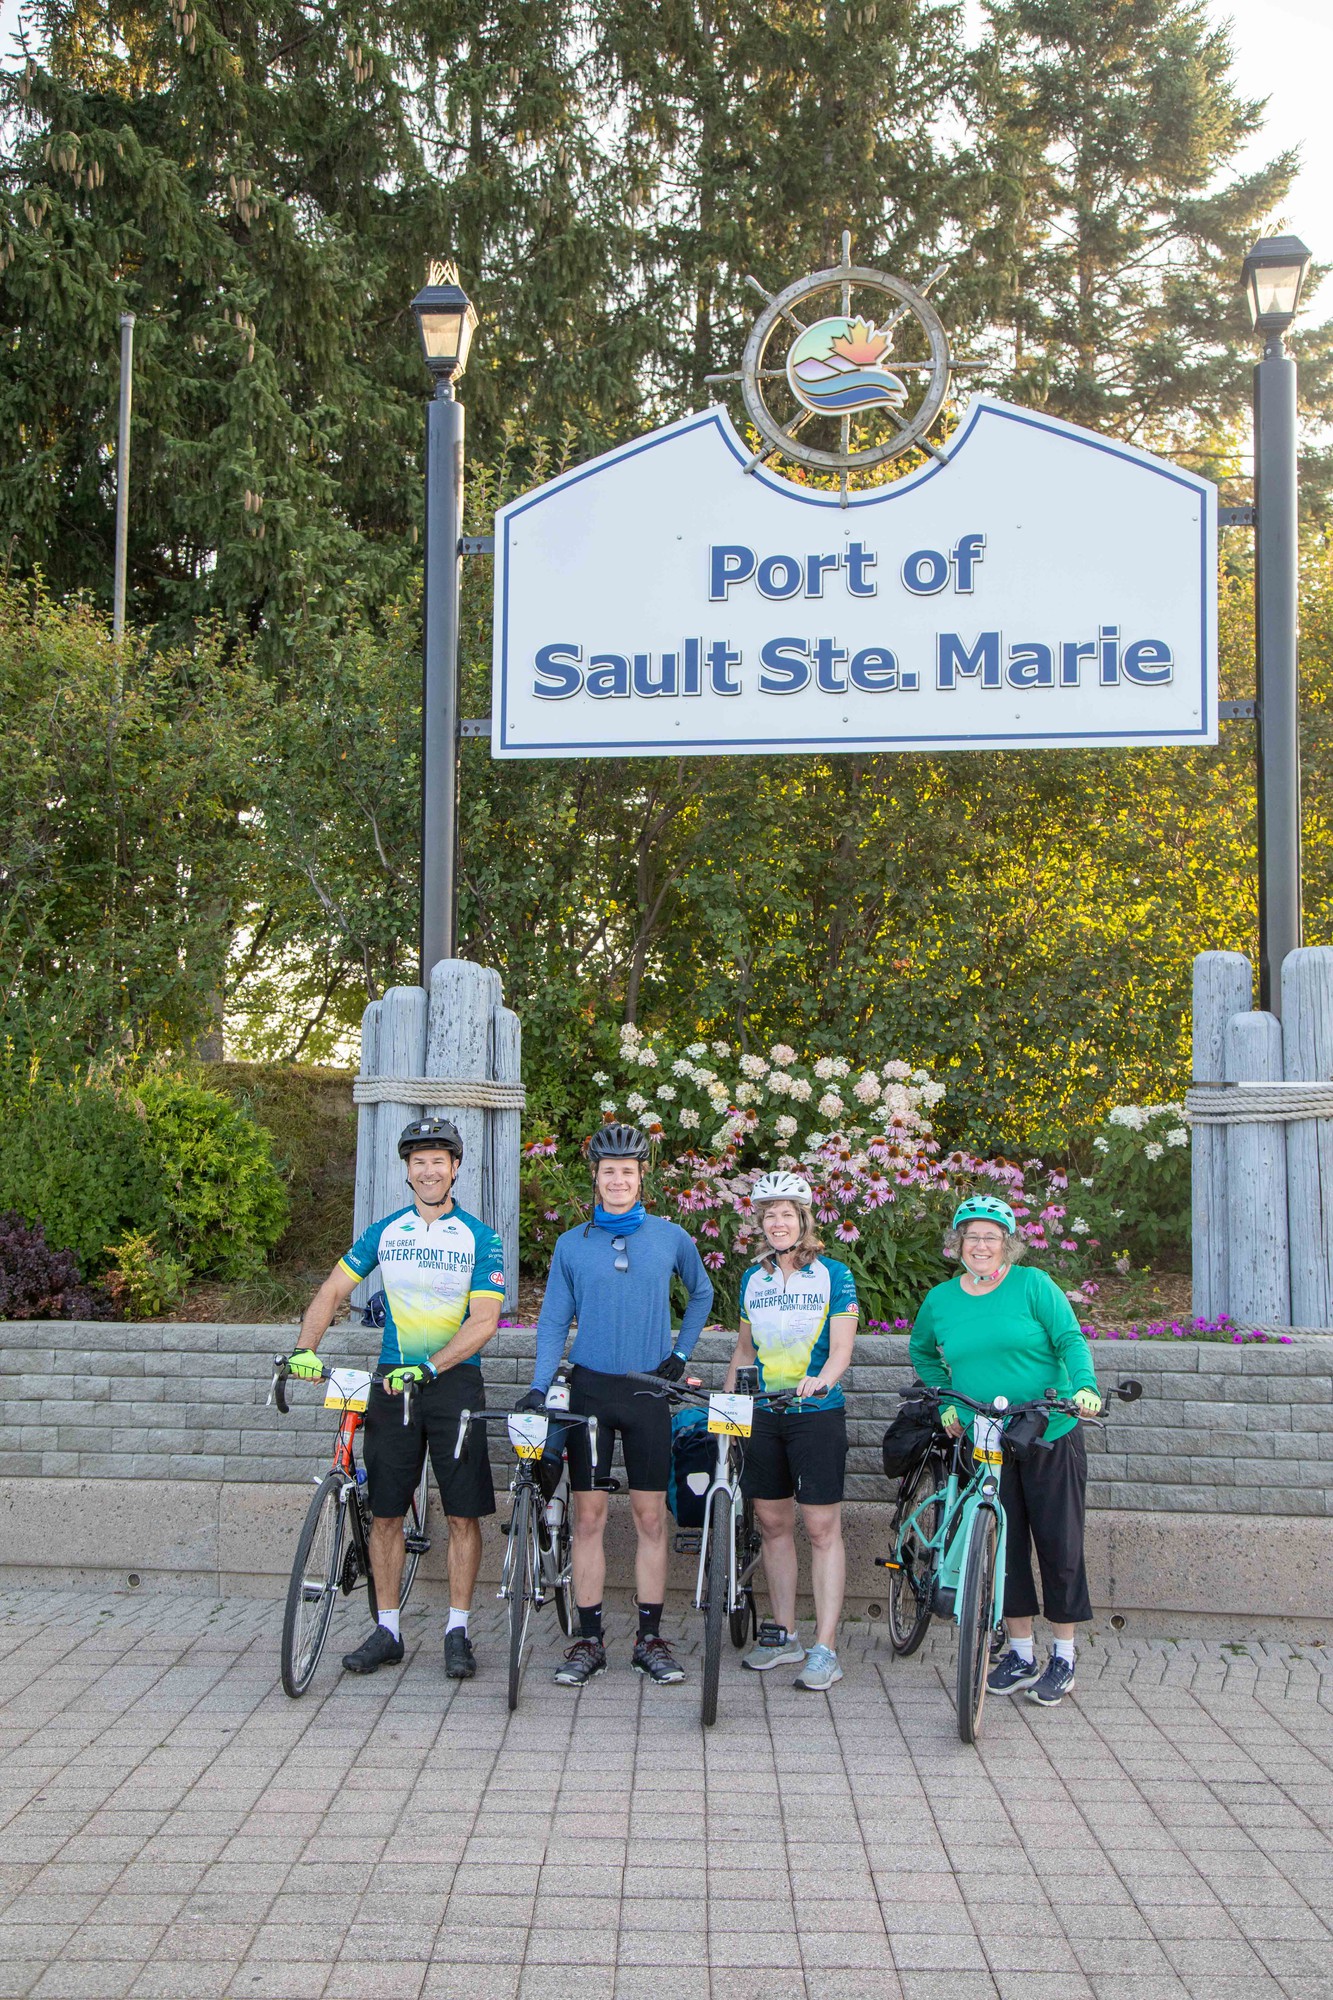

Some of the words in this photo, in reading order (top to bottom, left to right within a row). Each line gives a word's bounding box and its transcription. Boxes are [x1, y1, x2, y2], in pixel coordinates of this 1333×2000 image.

[708, 536, 877, 601] Port
[901, 533, 986, 595] of
[533, 637, 742, 700] Sault
[758, 636, 918, 694] Ste.
[936, 625, 1174, 690] Marie
[385, 1240, 396, 1248] THE
[397, 1239, 416, 1247] GREAT
[379, 1248, 445, 1262] WATERFRONT
[447, 1250, 475, 1265] TRAIL
[418, 1260, 458, 1272] ADVENTURE
[764, 1288, 778, 1296] GREAT
[749, 1293, 800, 1309] WATERFRONT
[803, 1293, 825, 1304] TRAIL
[725, 1422, 734, 1431] 65
[522, 1446, 530, 1454] 24
